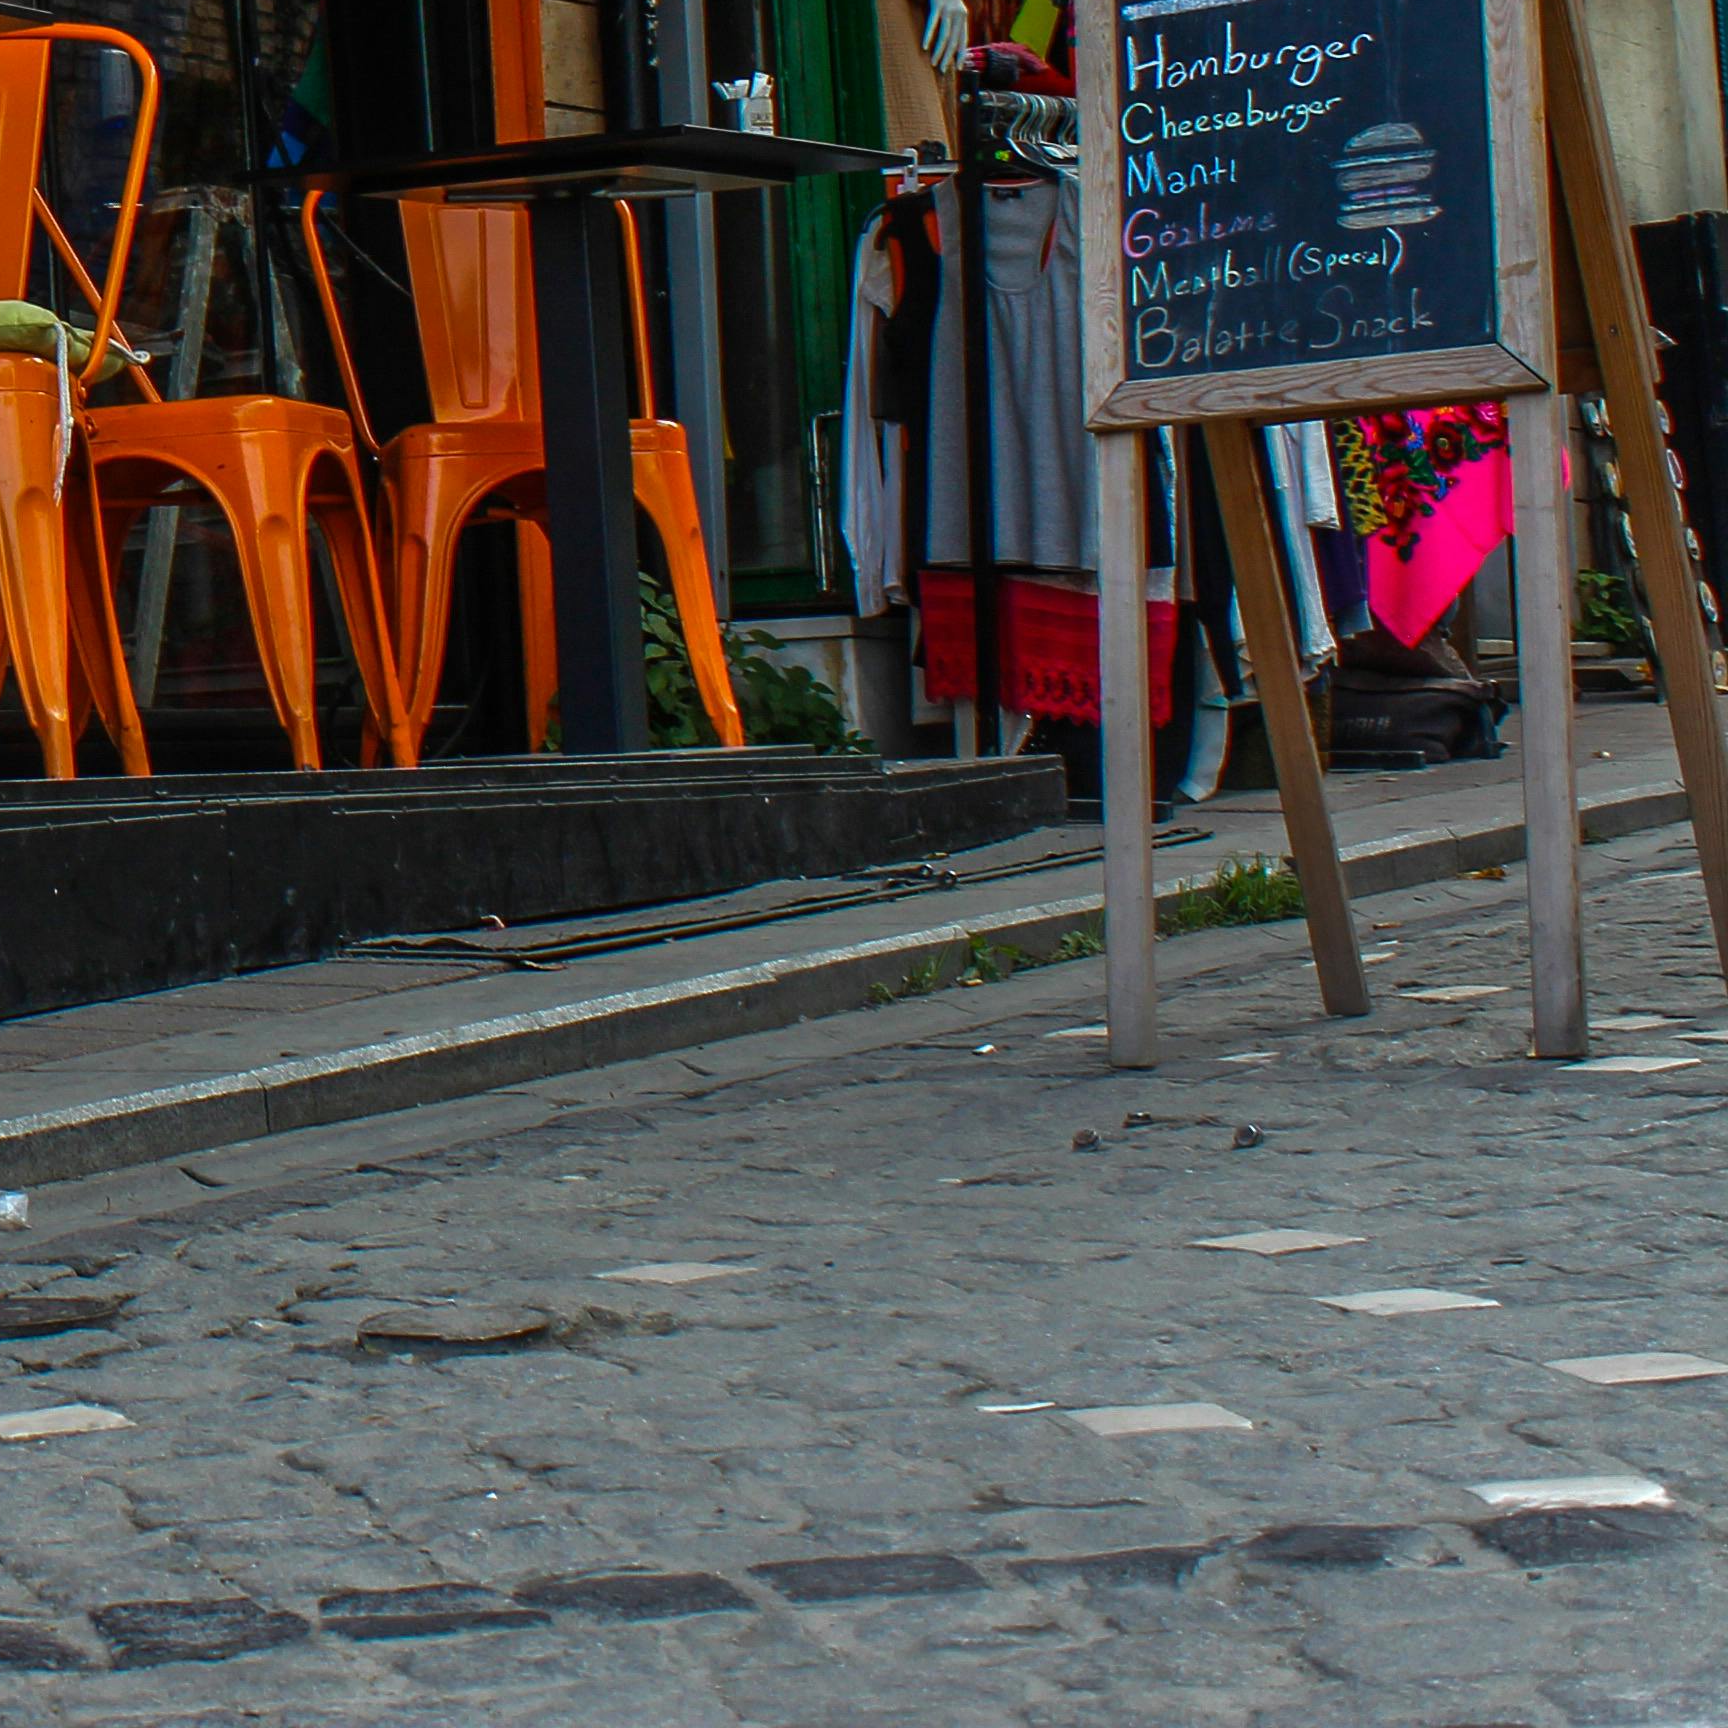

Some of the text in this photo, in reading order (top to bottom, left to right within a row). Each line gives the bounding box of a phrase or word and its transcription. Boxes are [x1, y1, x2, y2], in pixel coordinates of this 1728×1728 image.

[1125, 21, 1375, 92] Hamburger
[1121, 88, 1342, 145] Cheeseburger
[1131, 243, 1282, 307] Meatball
[1135, 284, 1434, 368] Balatte Snack
